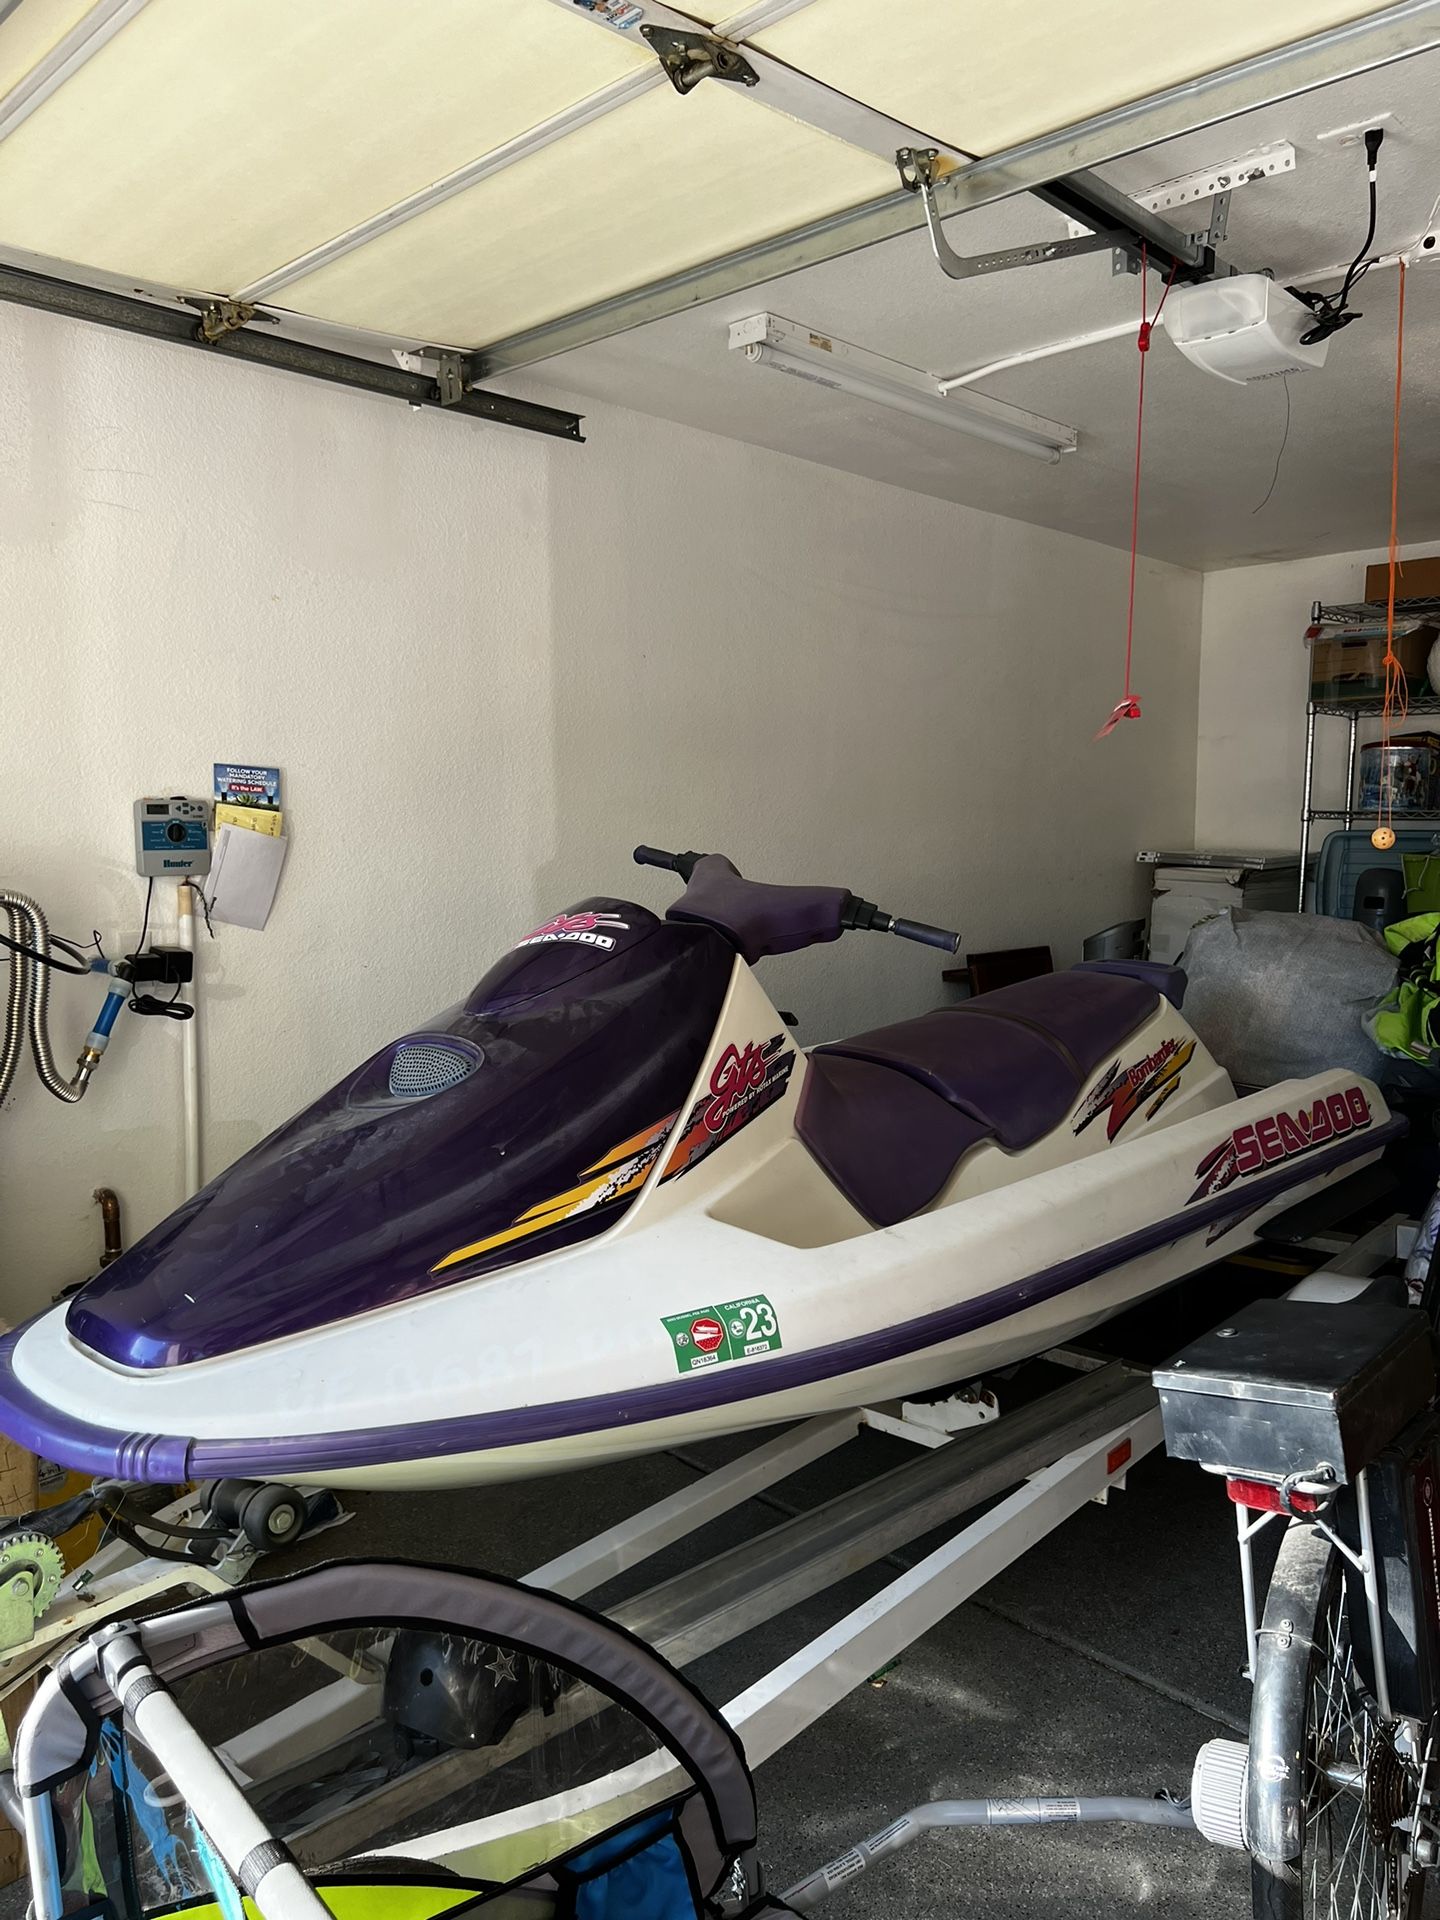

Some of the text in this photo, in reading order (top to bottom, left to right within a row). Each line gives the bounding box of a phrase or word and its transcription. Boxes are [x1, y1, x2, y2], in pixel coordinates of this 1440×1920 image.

[163, 859, 193, 868] Hunter
[722, 1096, 748, 1118] POWERED
[749, 1091, 756, 1099] BY
[757, 1078, 771, 1093] ROTAX
[724, 1298, 760, 1310] CALIFORNIA
[740, 1303, 777, 1340] 23
